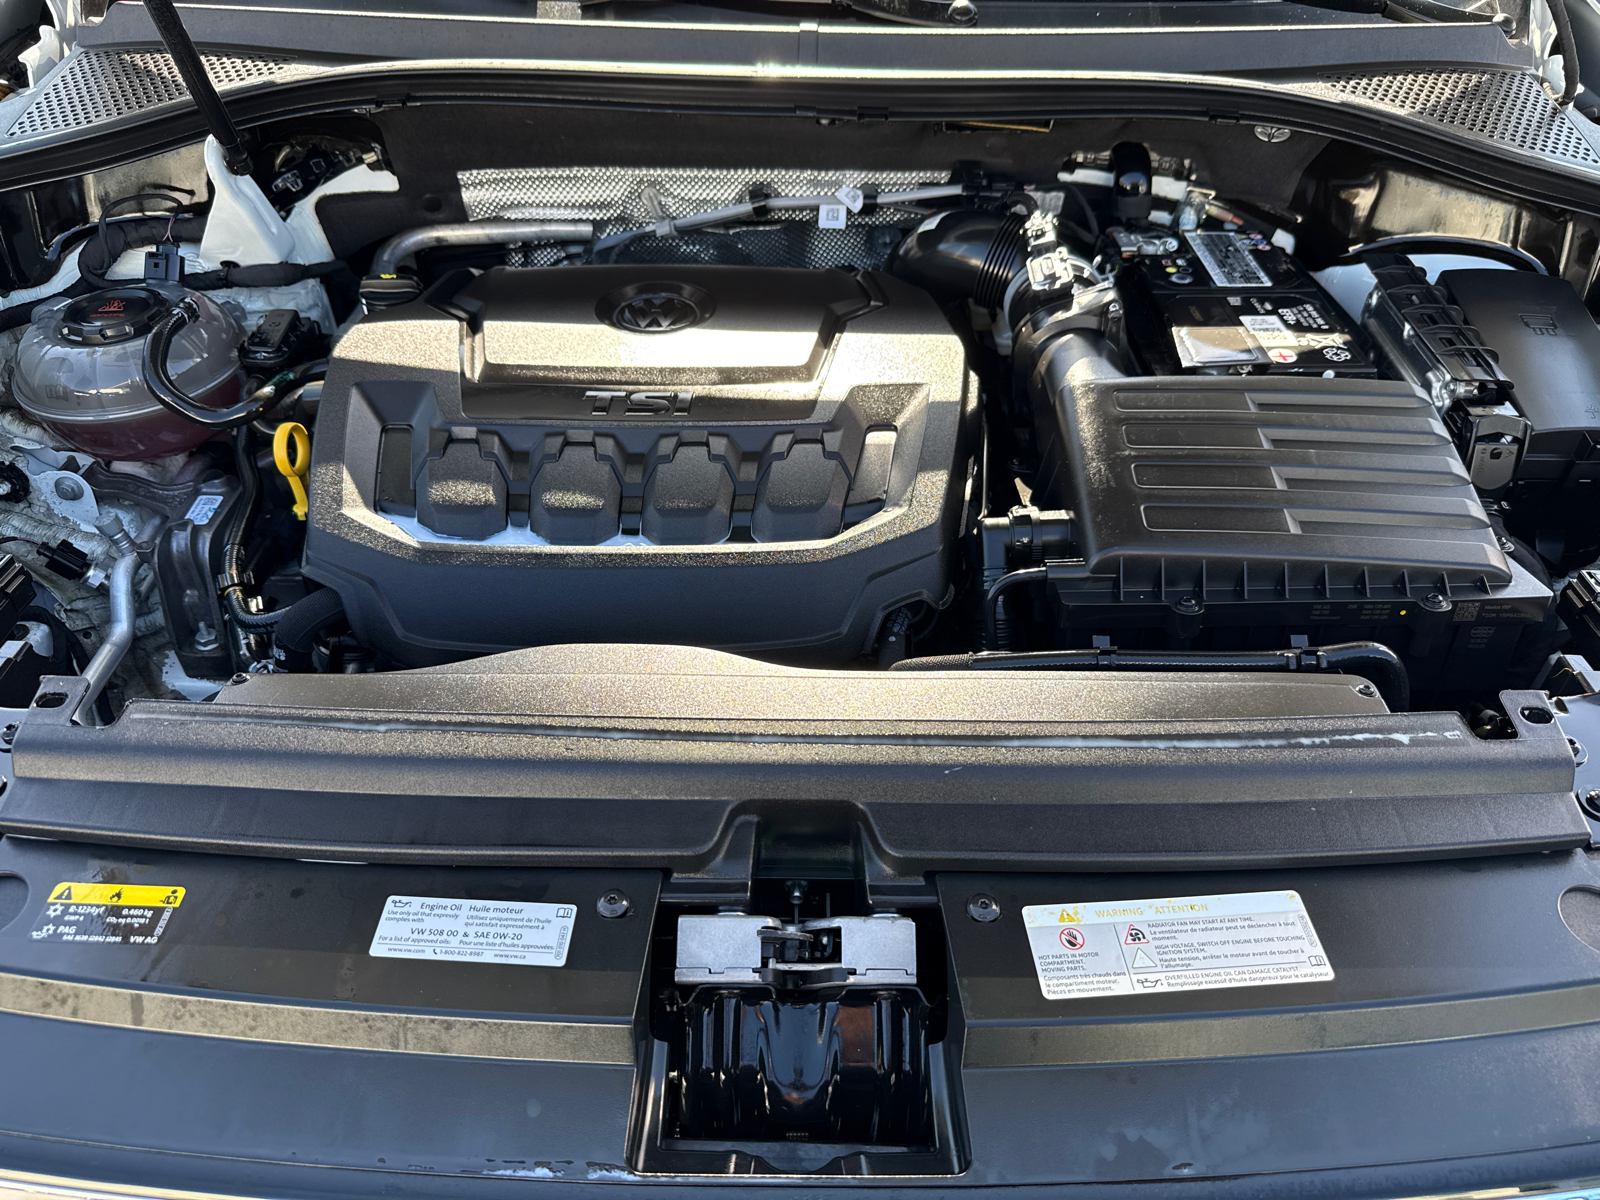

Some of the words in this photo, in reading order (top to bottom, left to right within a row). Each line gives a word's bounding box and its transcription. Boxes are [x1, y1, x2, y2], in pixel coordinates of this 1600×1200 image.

[612, 292, 700, 332] VW
[583, 390, 696, 416] TSI
[68, 905, 106, 915] R-1234yf
[420, 902, 448, 911] Engine
[1155, 904, 1209, 914] ATTENTION
[122, 908, 143, 916] 0.460
[143, 908, 153, 918] kg
[1095, 908, 1143, 918] WARNING
[1052, 980, 1094, 988] compartiment
